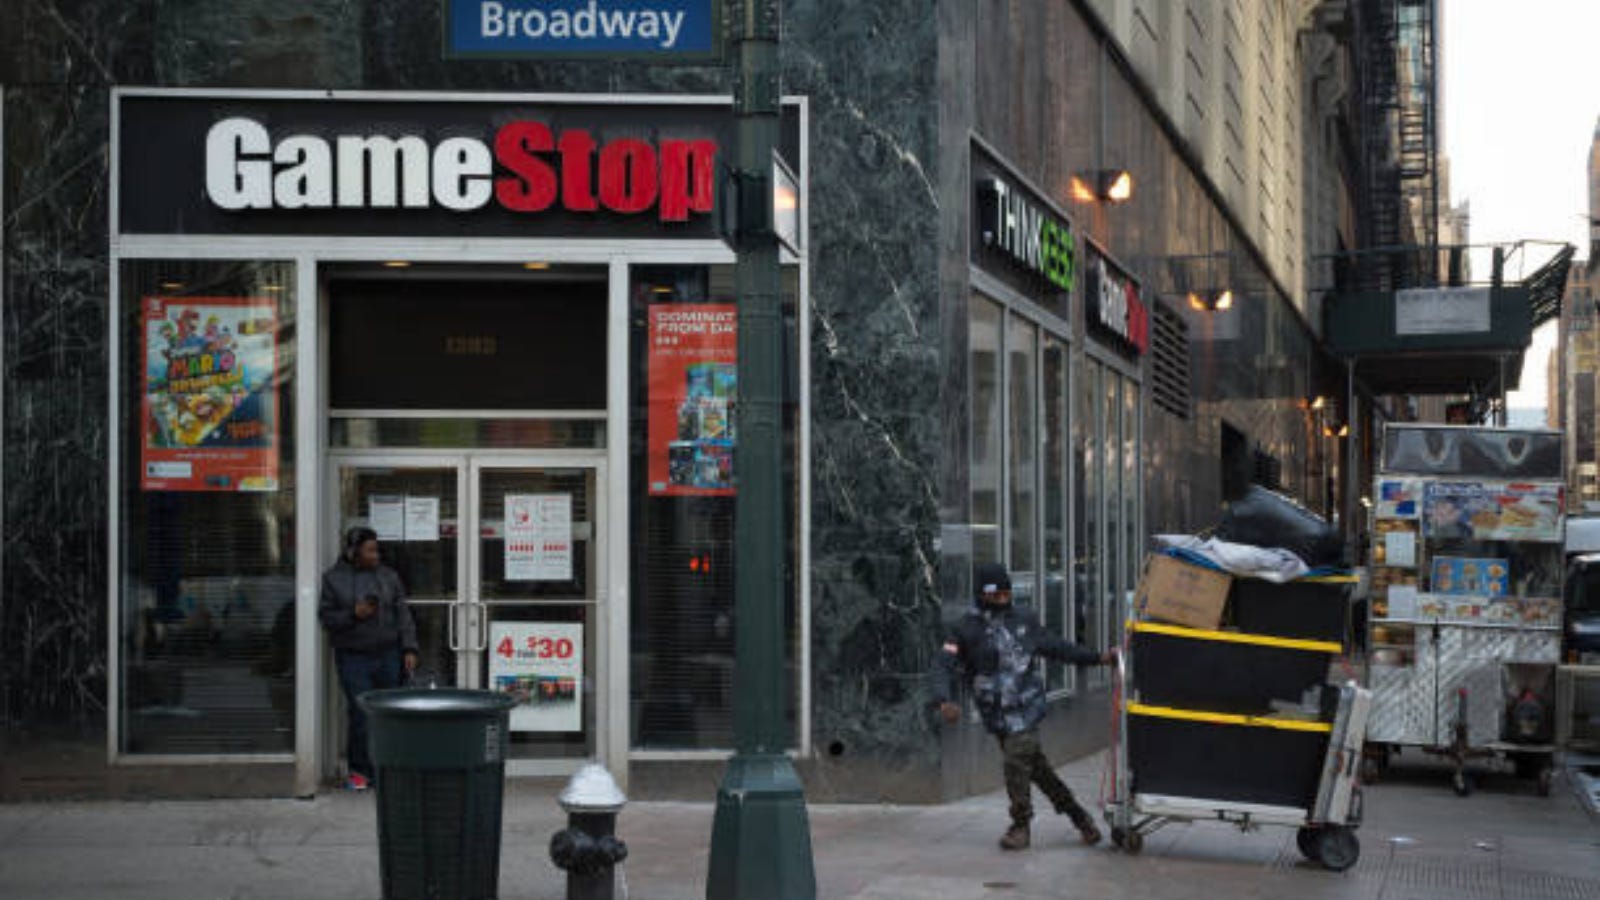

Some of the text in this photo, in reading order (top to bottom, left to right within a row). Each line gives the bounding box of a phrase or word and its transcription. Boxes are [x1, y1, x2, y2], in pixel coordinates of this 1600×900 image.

[480, 0, 685, 48] Broadway
[205, 116, 717, 222] GameStop
[656, 311, 734, 321] DOMINAT
[710, 322, 734, 334] DA
[496, 635, 515, 659] 4
